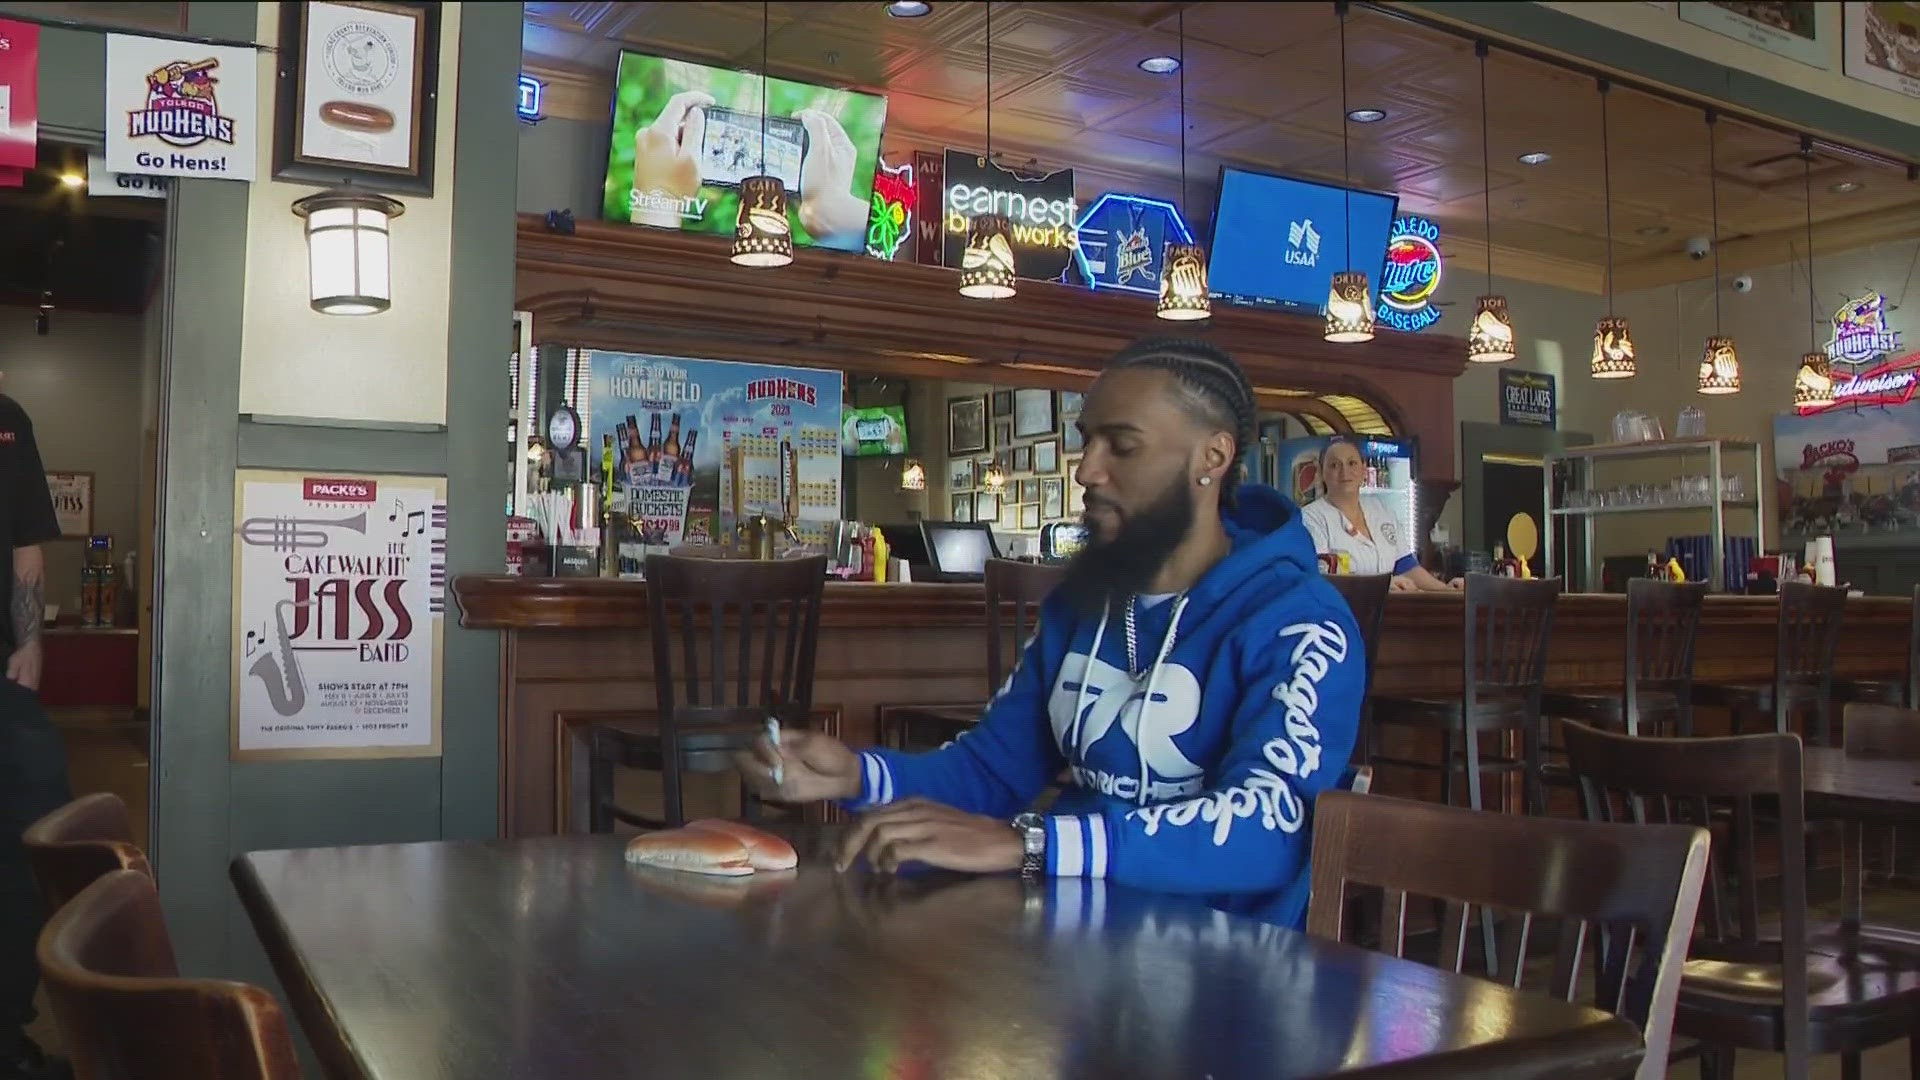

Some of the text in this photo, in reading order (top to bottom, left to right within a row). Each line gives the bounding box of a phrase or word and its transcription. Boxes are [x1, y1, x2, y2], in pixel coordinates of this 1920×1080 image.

[160, 99, 204, 110] TOLEDO
[131, 109, 232, 144] MUDHENS
[136, 152, 226, 171] Go Hens!
[949, 183, 1078, 229] earnest
[1013, 222, 1078, 250] works
[1285, 250, 1316, 267] USAA
[1377, 304, 1440, 331] BASEBALL
[610, 375, 702, 402] HOME FIELD
[312, 484, 368, 497] PACKO'S
[630, 488, 684, 502] DOMESTIC
[387, 542, 406, 554] THE
[284, 555, 410, 576] CAKEWALKIN'
[284, 577, 413, 640] JASS
[359, 643, 410, 662] BAND
[351, 682, 376, 690] START
